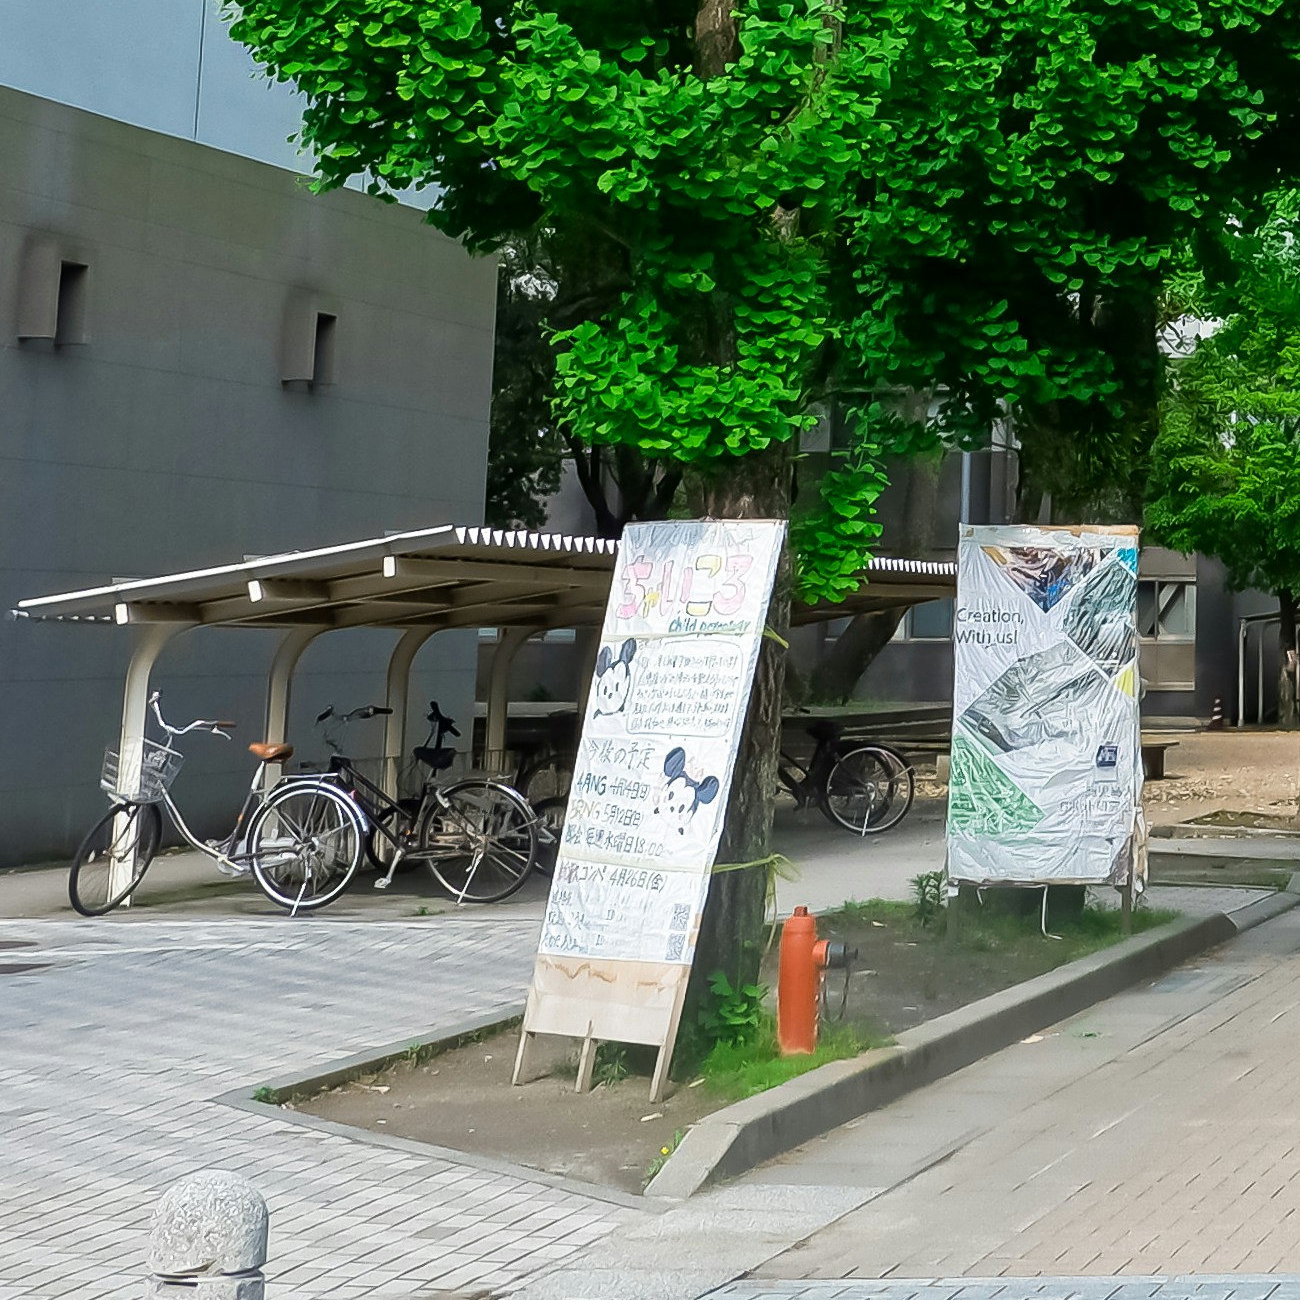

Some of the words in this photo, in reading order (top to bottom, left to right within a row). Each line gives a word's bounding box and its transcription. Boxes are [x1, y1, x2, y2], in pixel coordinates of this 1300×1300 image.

[956, 608, 1024, 625] Creation,
[955, 630, 991, 645] With
[588, 739, 655, 770] 今後の予定
